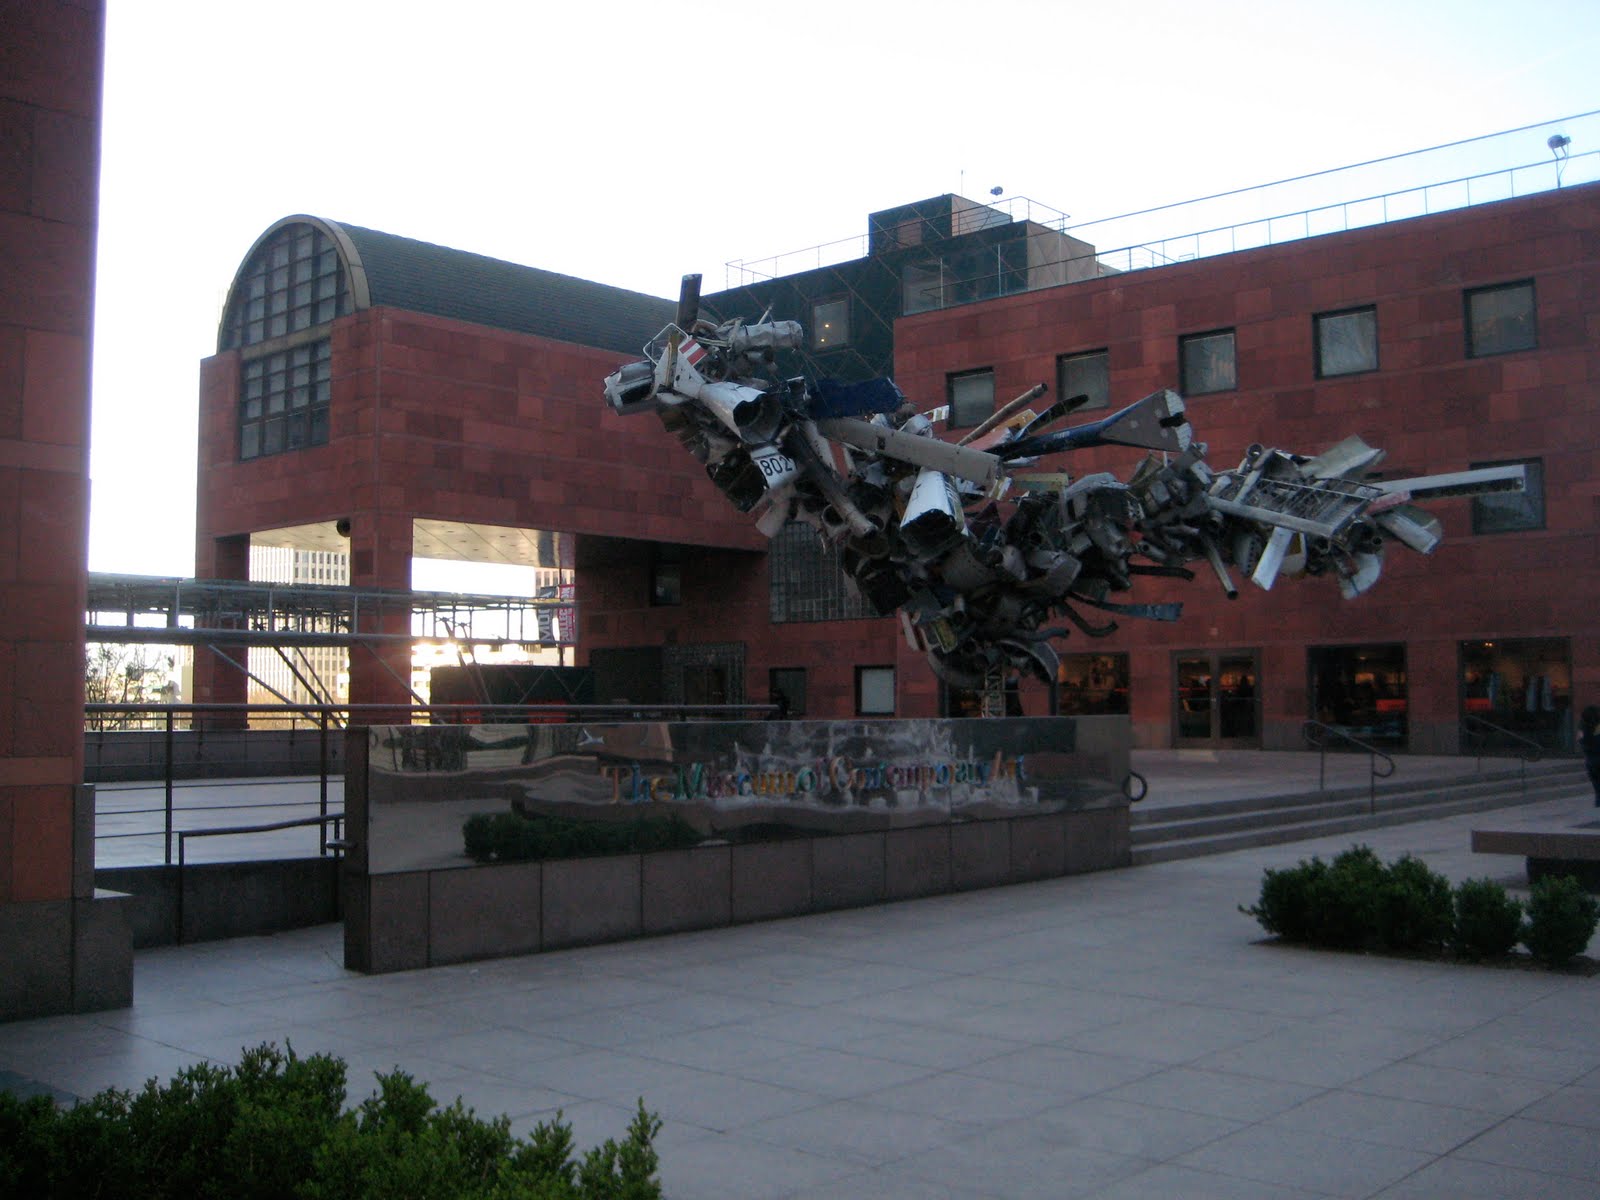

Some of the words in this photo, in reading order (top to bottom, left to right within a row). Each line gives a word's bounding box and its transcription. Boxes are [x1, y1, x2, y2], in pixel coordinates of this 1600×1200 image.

[760, 456, 792, 476] 802
[600, 761, 674, 803] The
[674, 762, 795, 799] Museum
[797, 756, 829, 792] of
[827, 756, 990, 793] Contemporary
